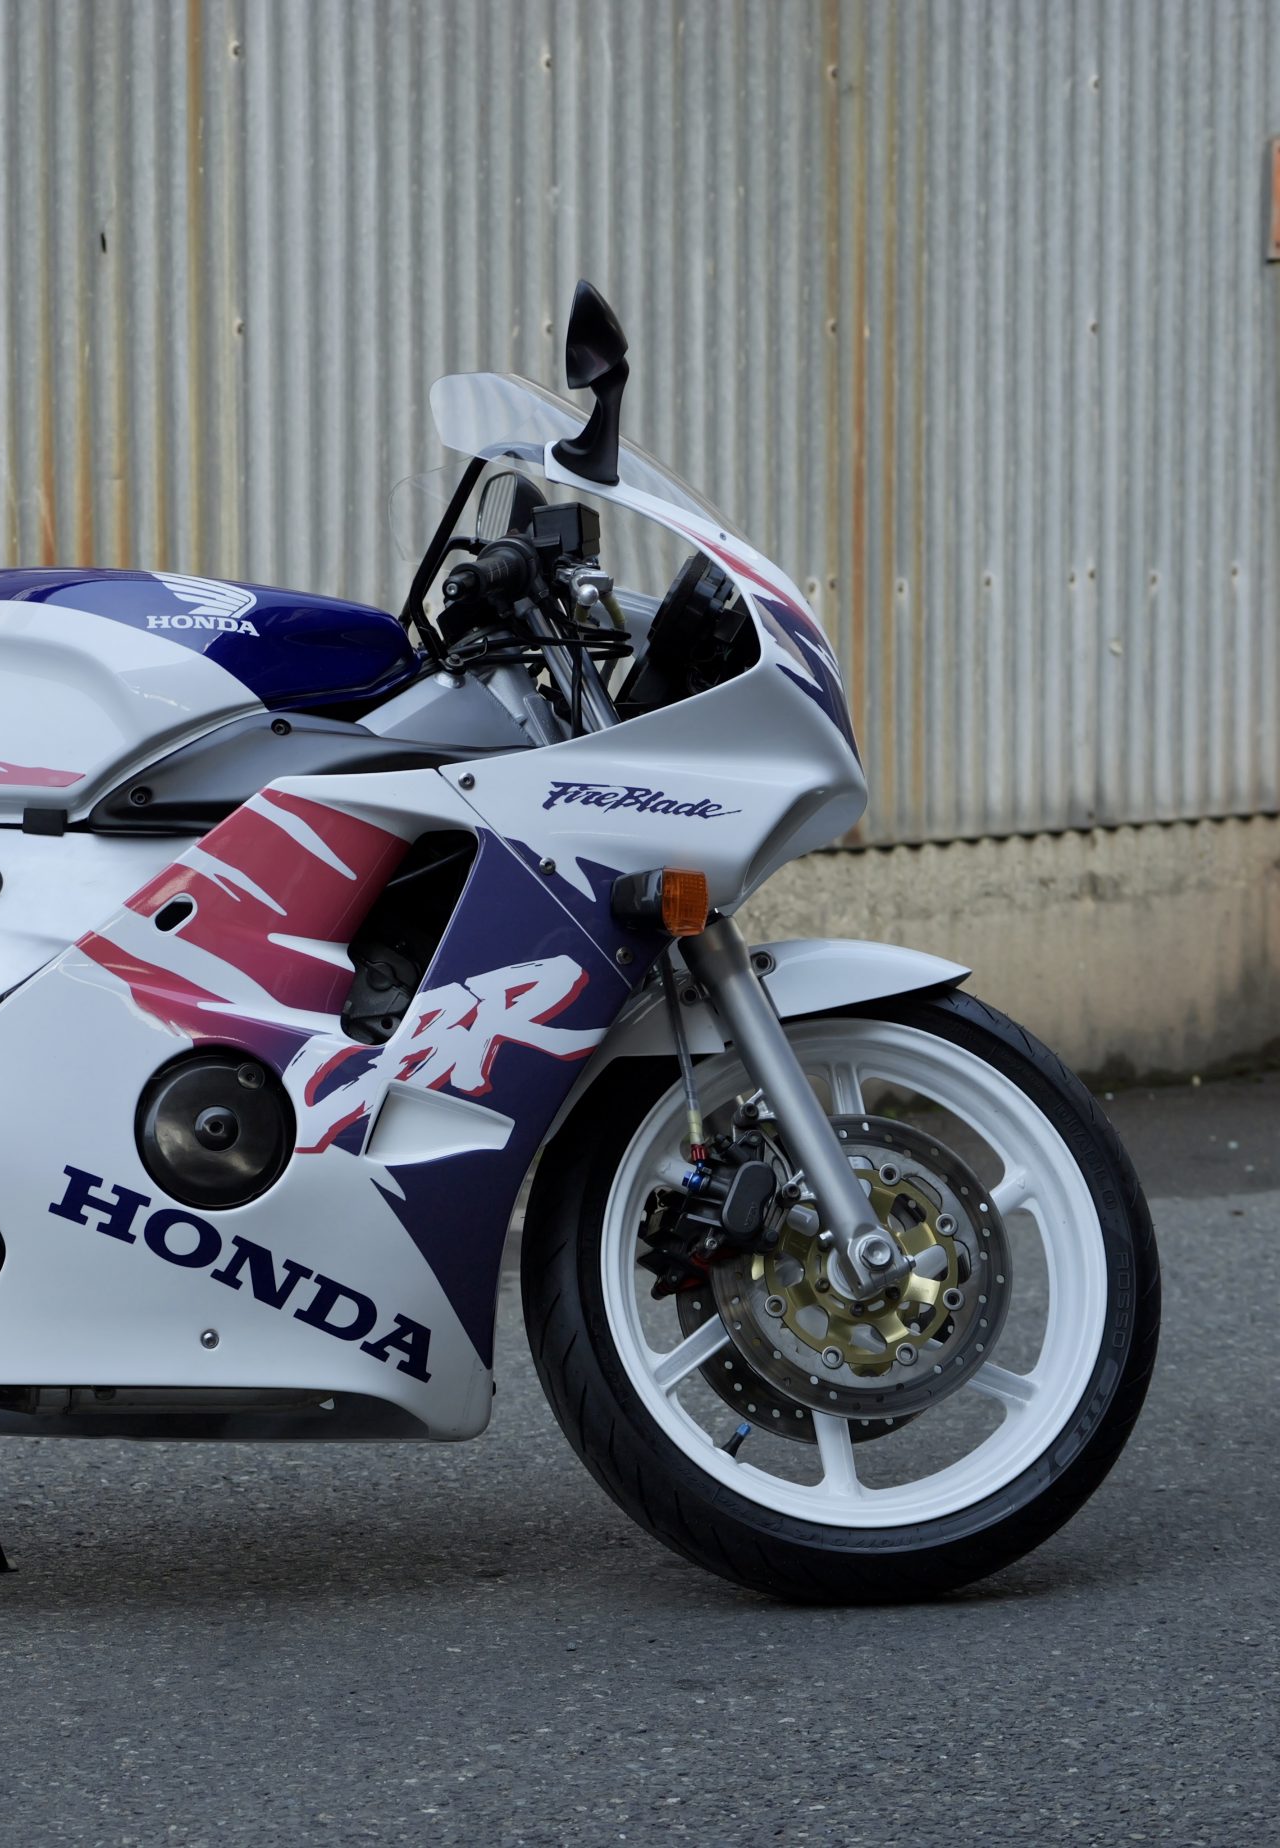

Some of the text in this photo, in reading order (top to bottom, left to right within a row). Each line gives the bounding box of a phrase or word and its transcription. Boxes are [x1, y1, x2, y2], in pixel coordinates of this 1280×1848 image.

[146, 615, 260, 637] HONDA
[542, 781, 743, 819] FireBlade
[48, 1164, 432, 1384] HONDA
[1112, 1251, 1131, 1348] ROSSO
